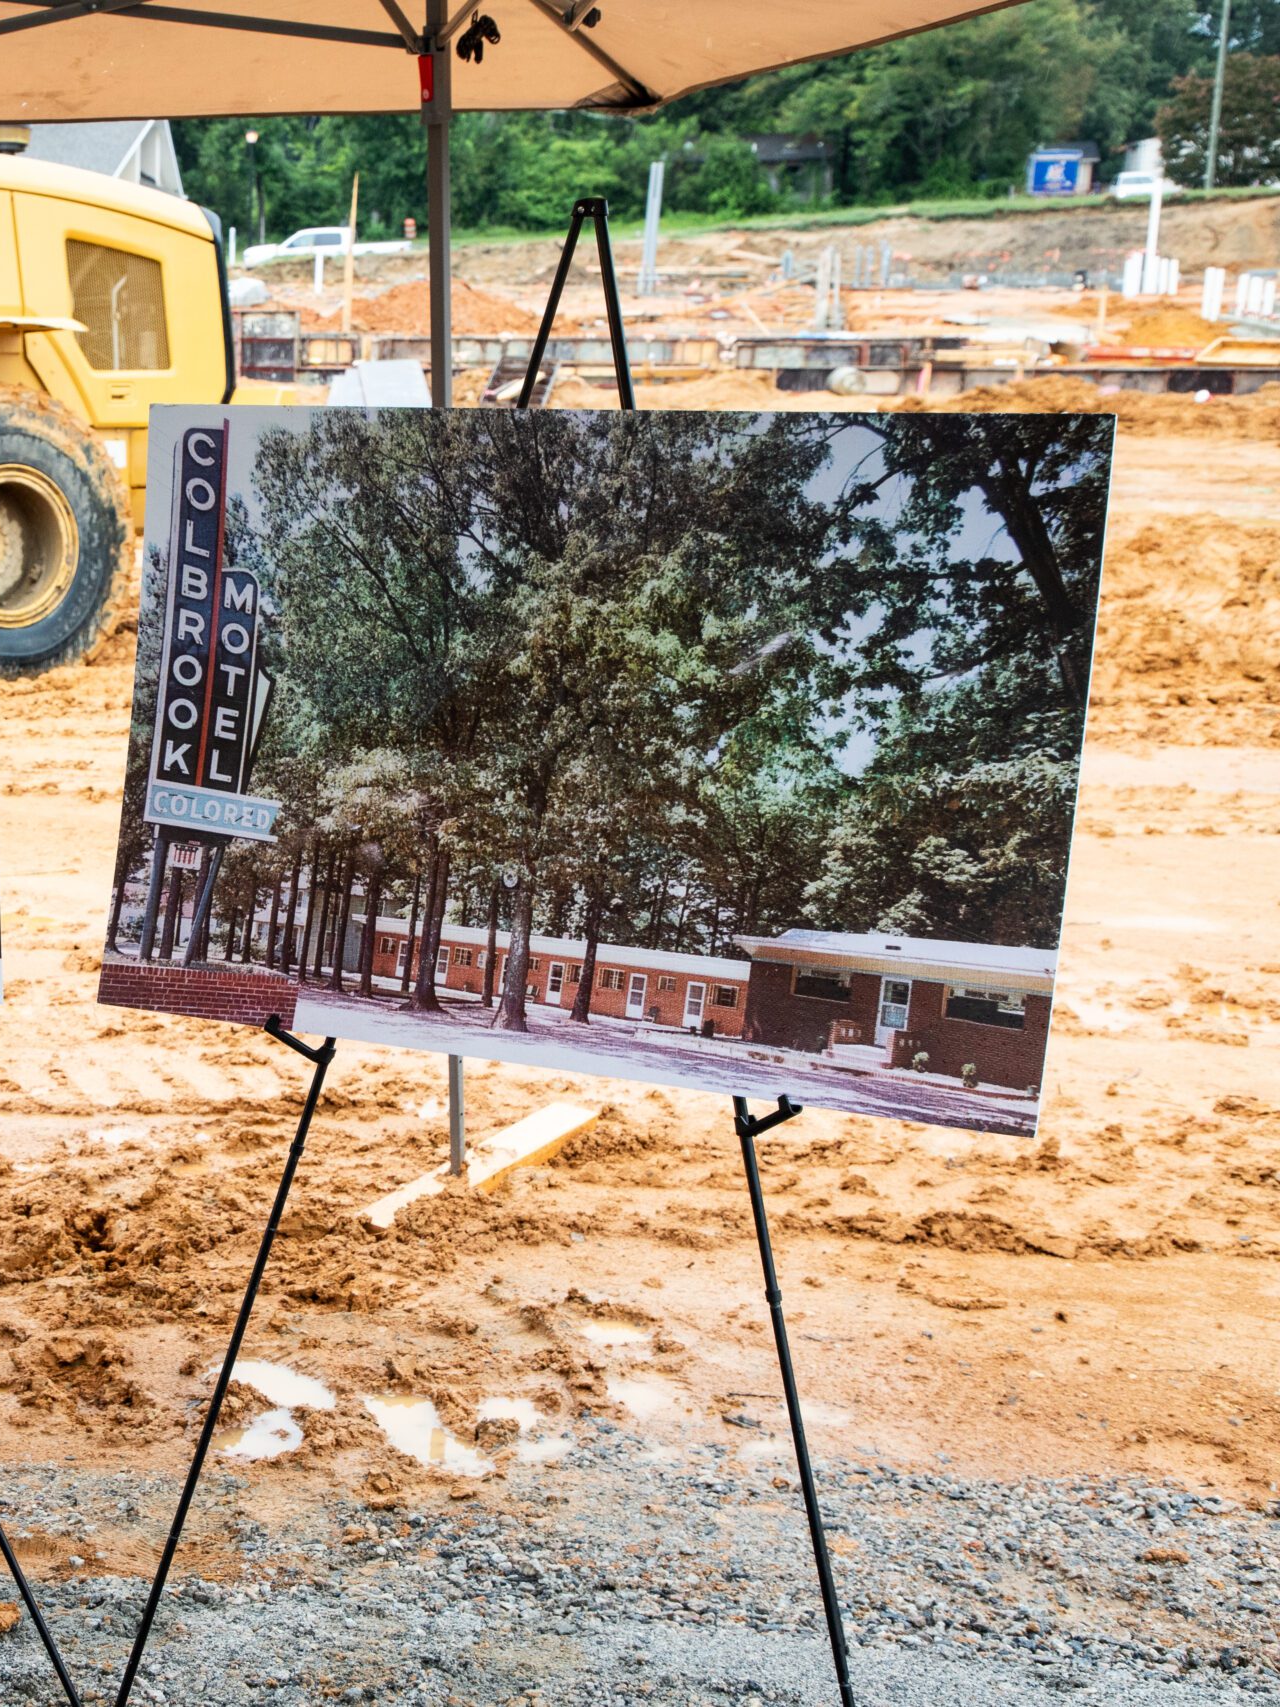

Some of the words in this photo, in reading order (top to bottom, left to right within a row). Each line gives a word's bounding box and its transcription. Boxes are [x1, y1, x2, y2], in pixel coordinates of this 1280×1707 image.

[163, 432, 216, 775] COLBROOK
[209, 577, 254, 783] MOTEL
[153, 791, 270, 830] COLORED
